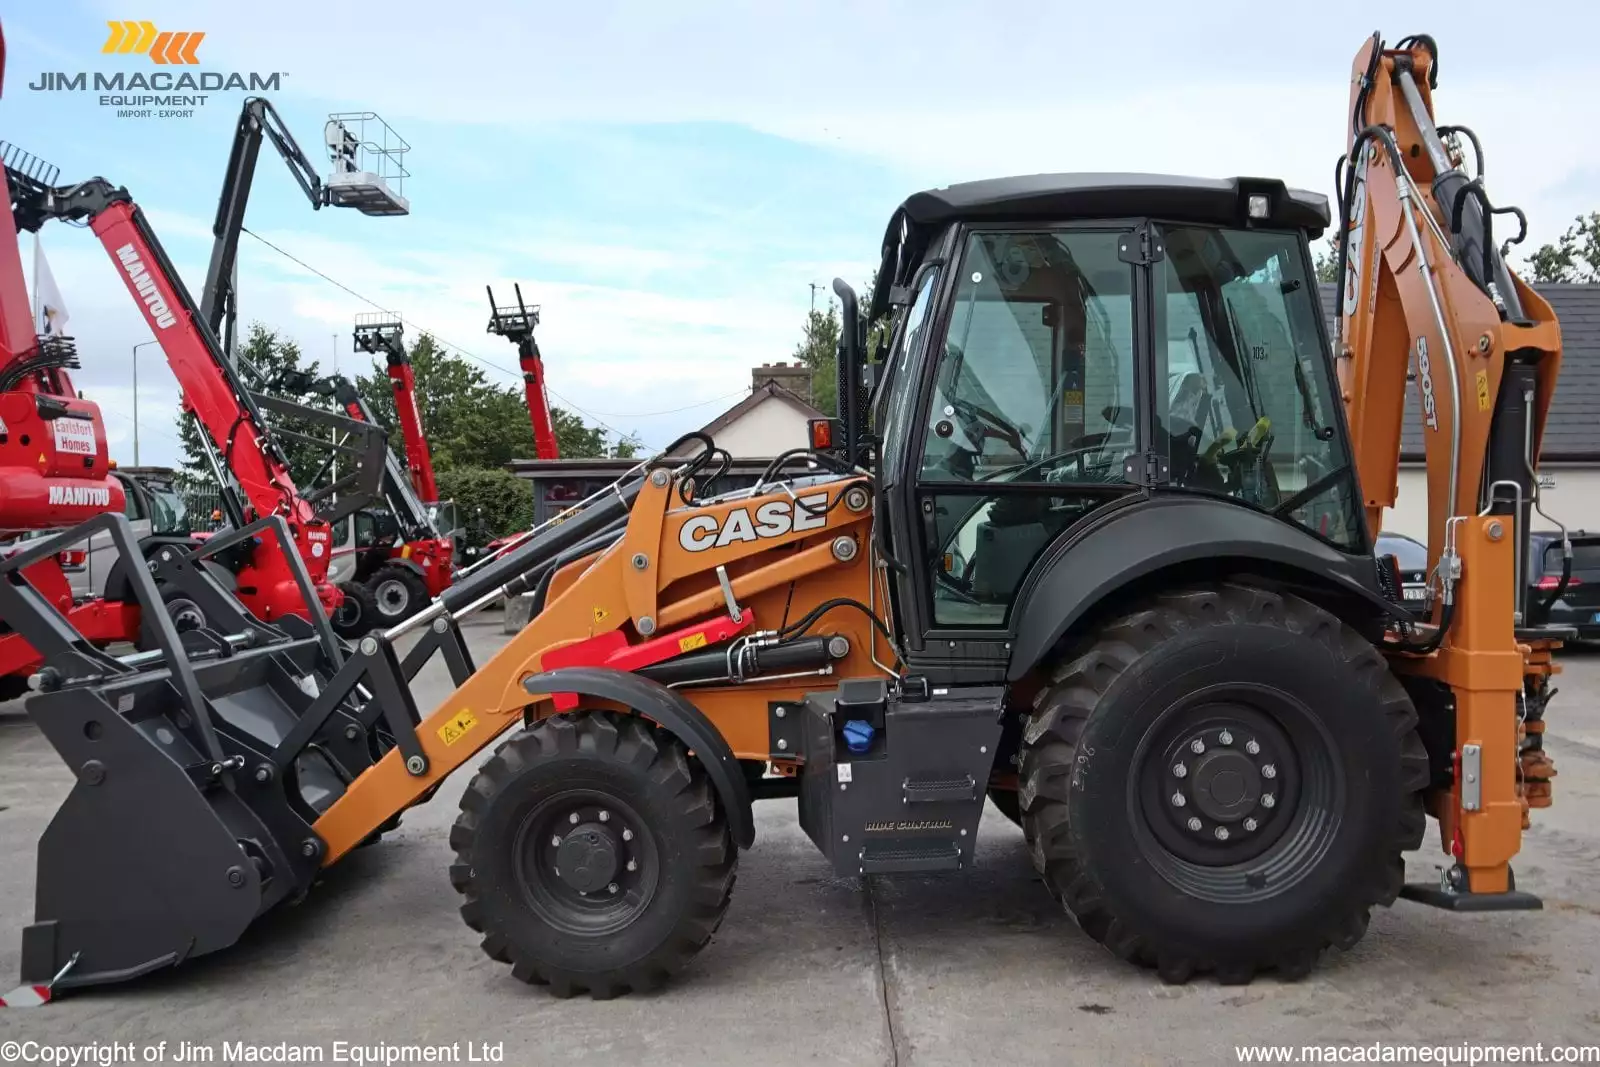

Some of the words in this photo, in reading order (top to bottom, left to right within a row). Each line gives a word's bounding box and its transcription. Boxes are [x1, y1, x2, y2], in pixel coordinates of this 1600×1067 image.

[116, 243, 177, 329] MANITOU
[1253, 346, 1265, 360] 103
[1416, 336, 1438, 432] 590ST
[61, 436, 91, 452] Homes
[48, 486, 110, 506] MANITOU
[679, 491, 829, 552] CASE
